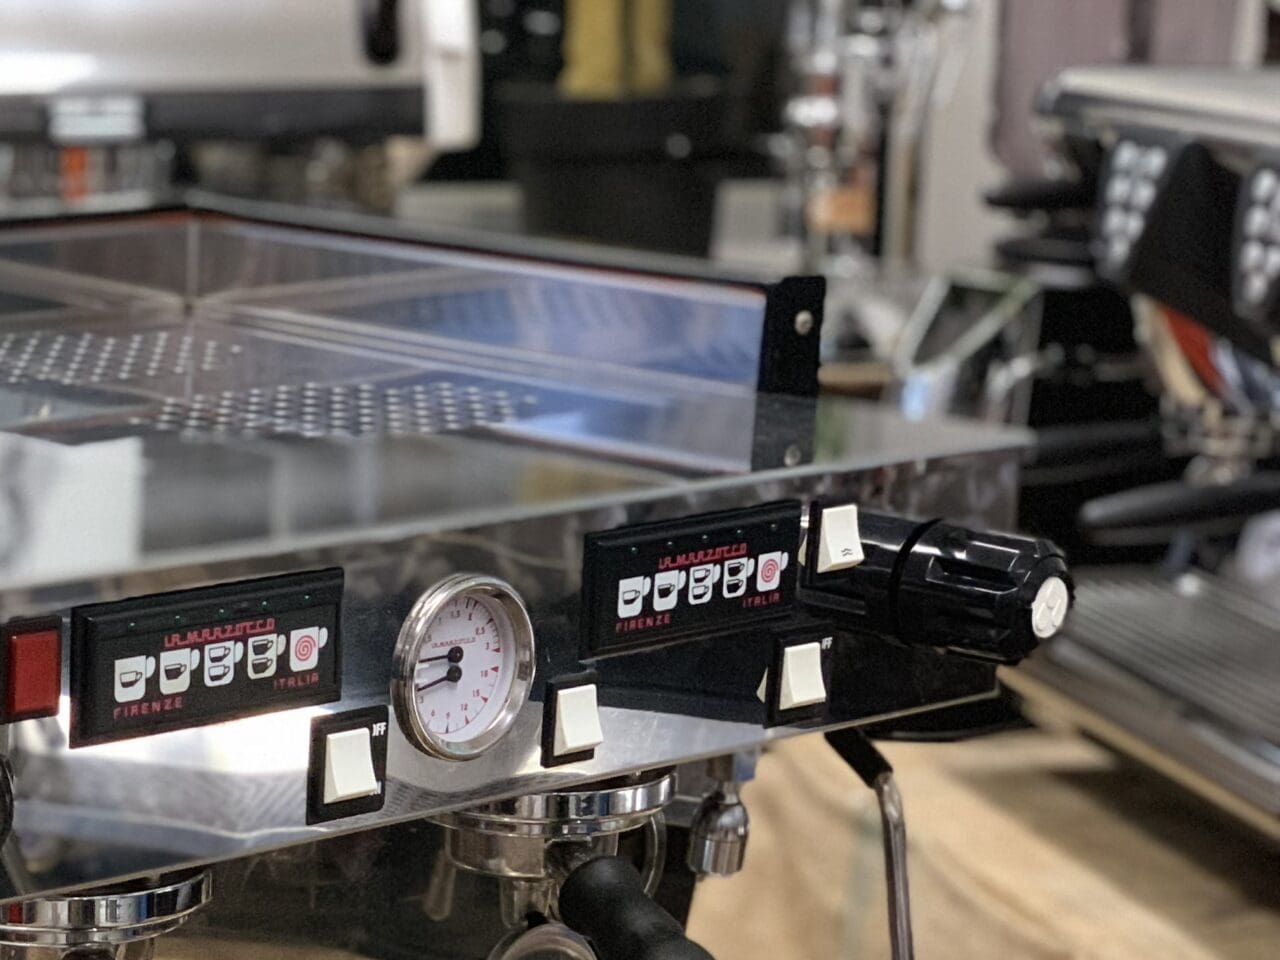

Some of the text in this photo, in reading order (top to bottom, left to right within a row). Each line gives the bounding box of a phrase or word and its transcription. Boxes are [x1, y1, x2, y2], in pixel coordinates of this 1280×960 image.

[742, 592, 781, 608] ITALIA
[615, 614, 671, 632] FIRENZE
[273, 672, 320, 691] ITALIA
[113, 696, 183, 719] FIRENZE
